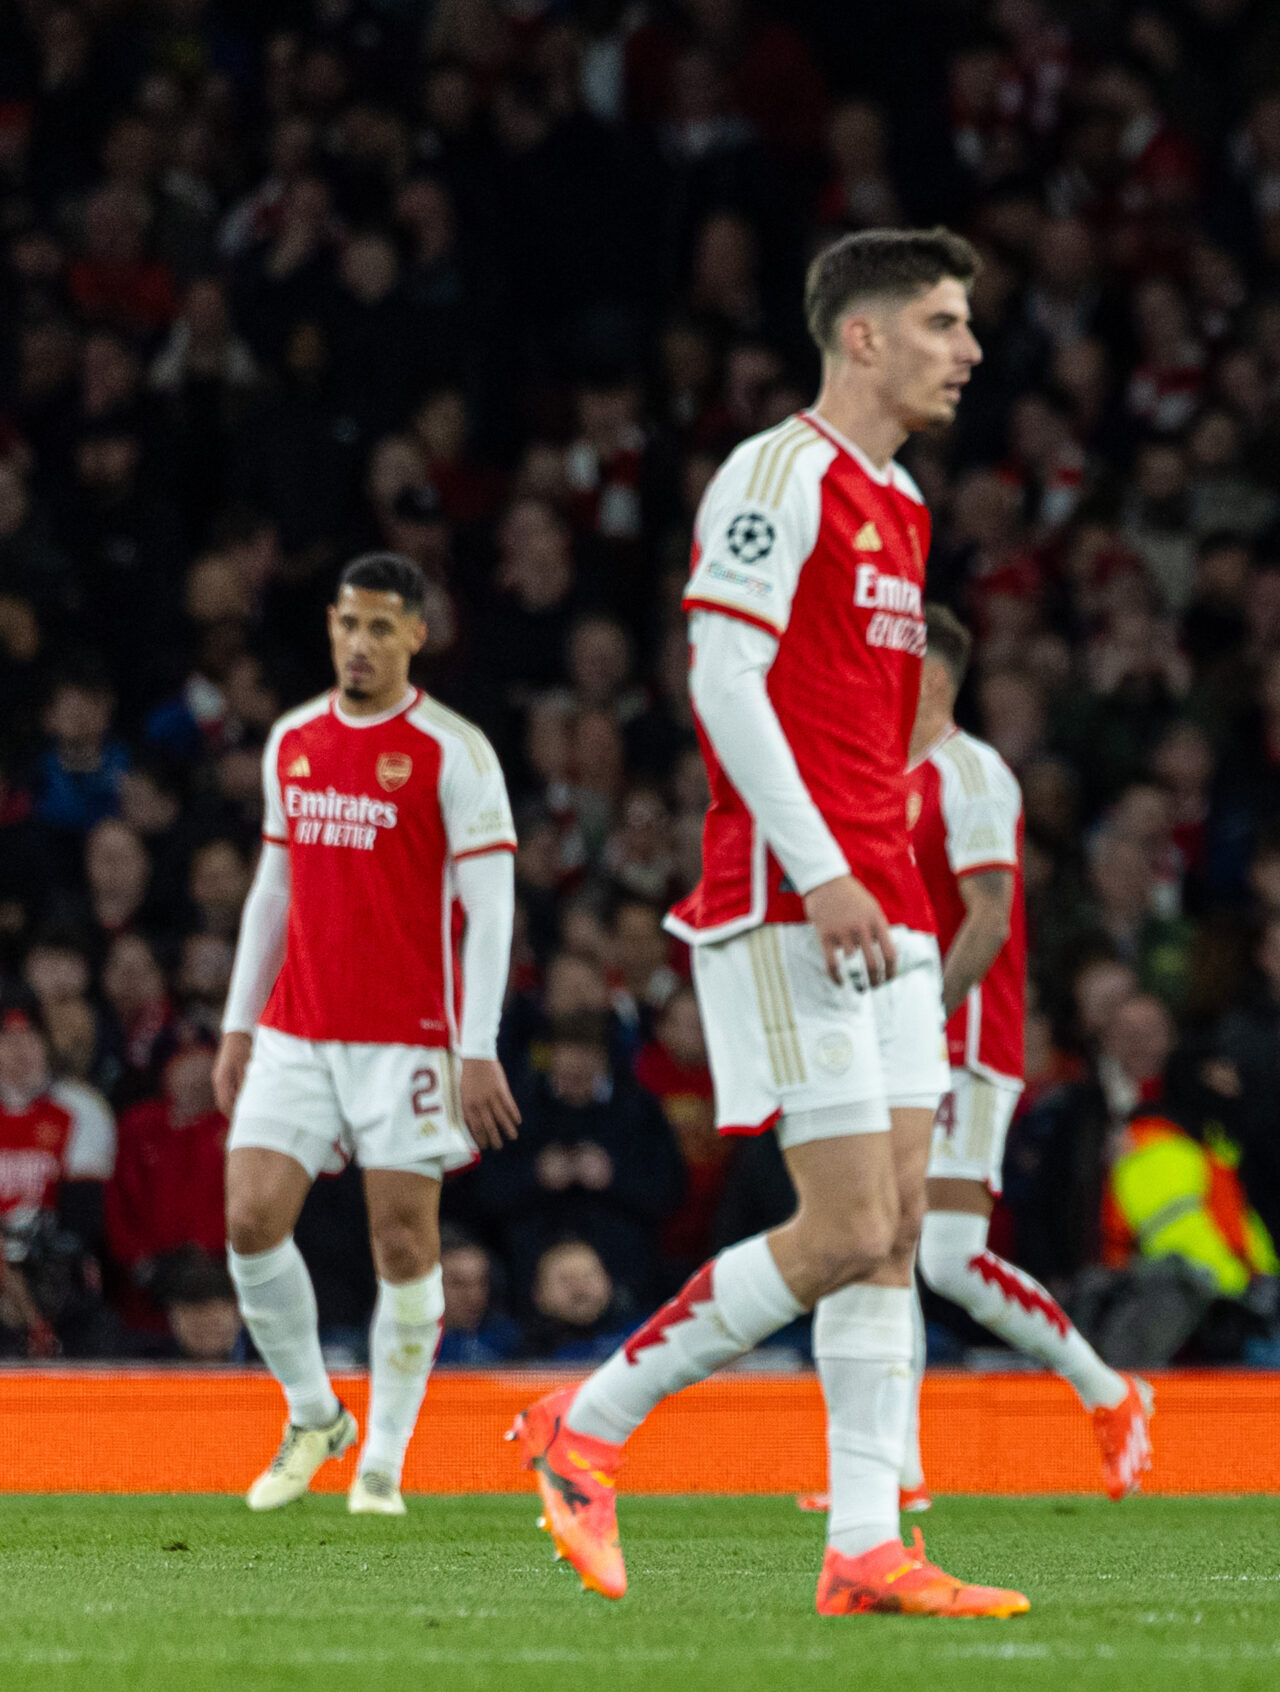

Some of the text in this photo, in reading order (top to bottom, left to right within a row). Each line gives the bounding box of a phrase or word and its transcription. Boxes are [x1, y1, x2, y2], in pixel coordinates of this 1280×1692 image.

[286, 785, 398, 829] Emirates
[322, 821, 377, 851] BETTER
[411, 1067, 441, 1115] 2
